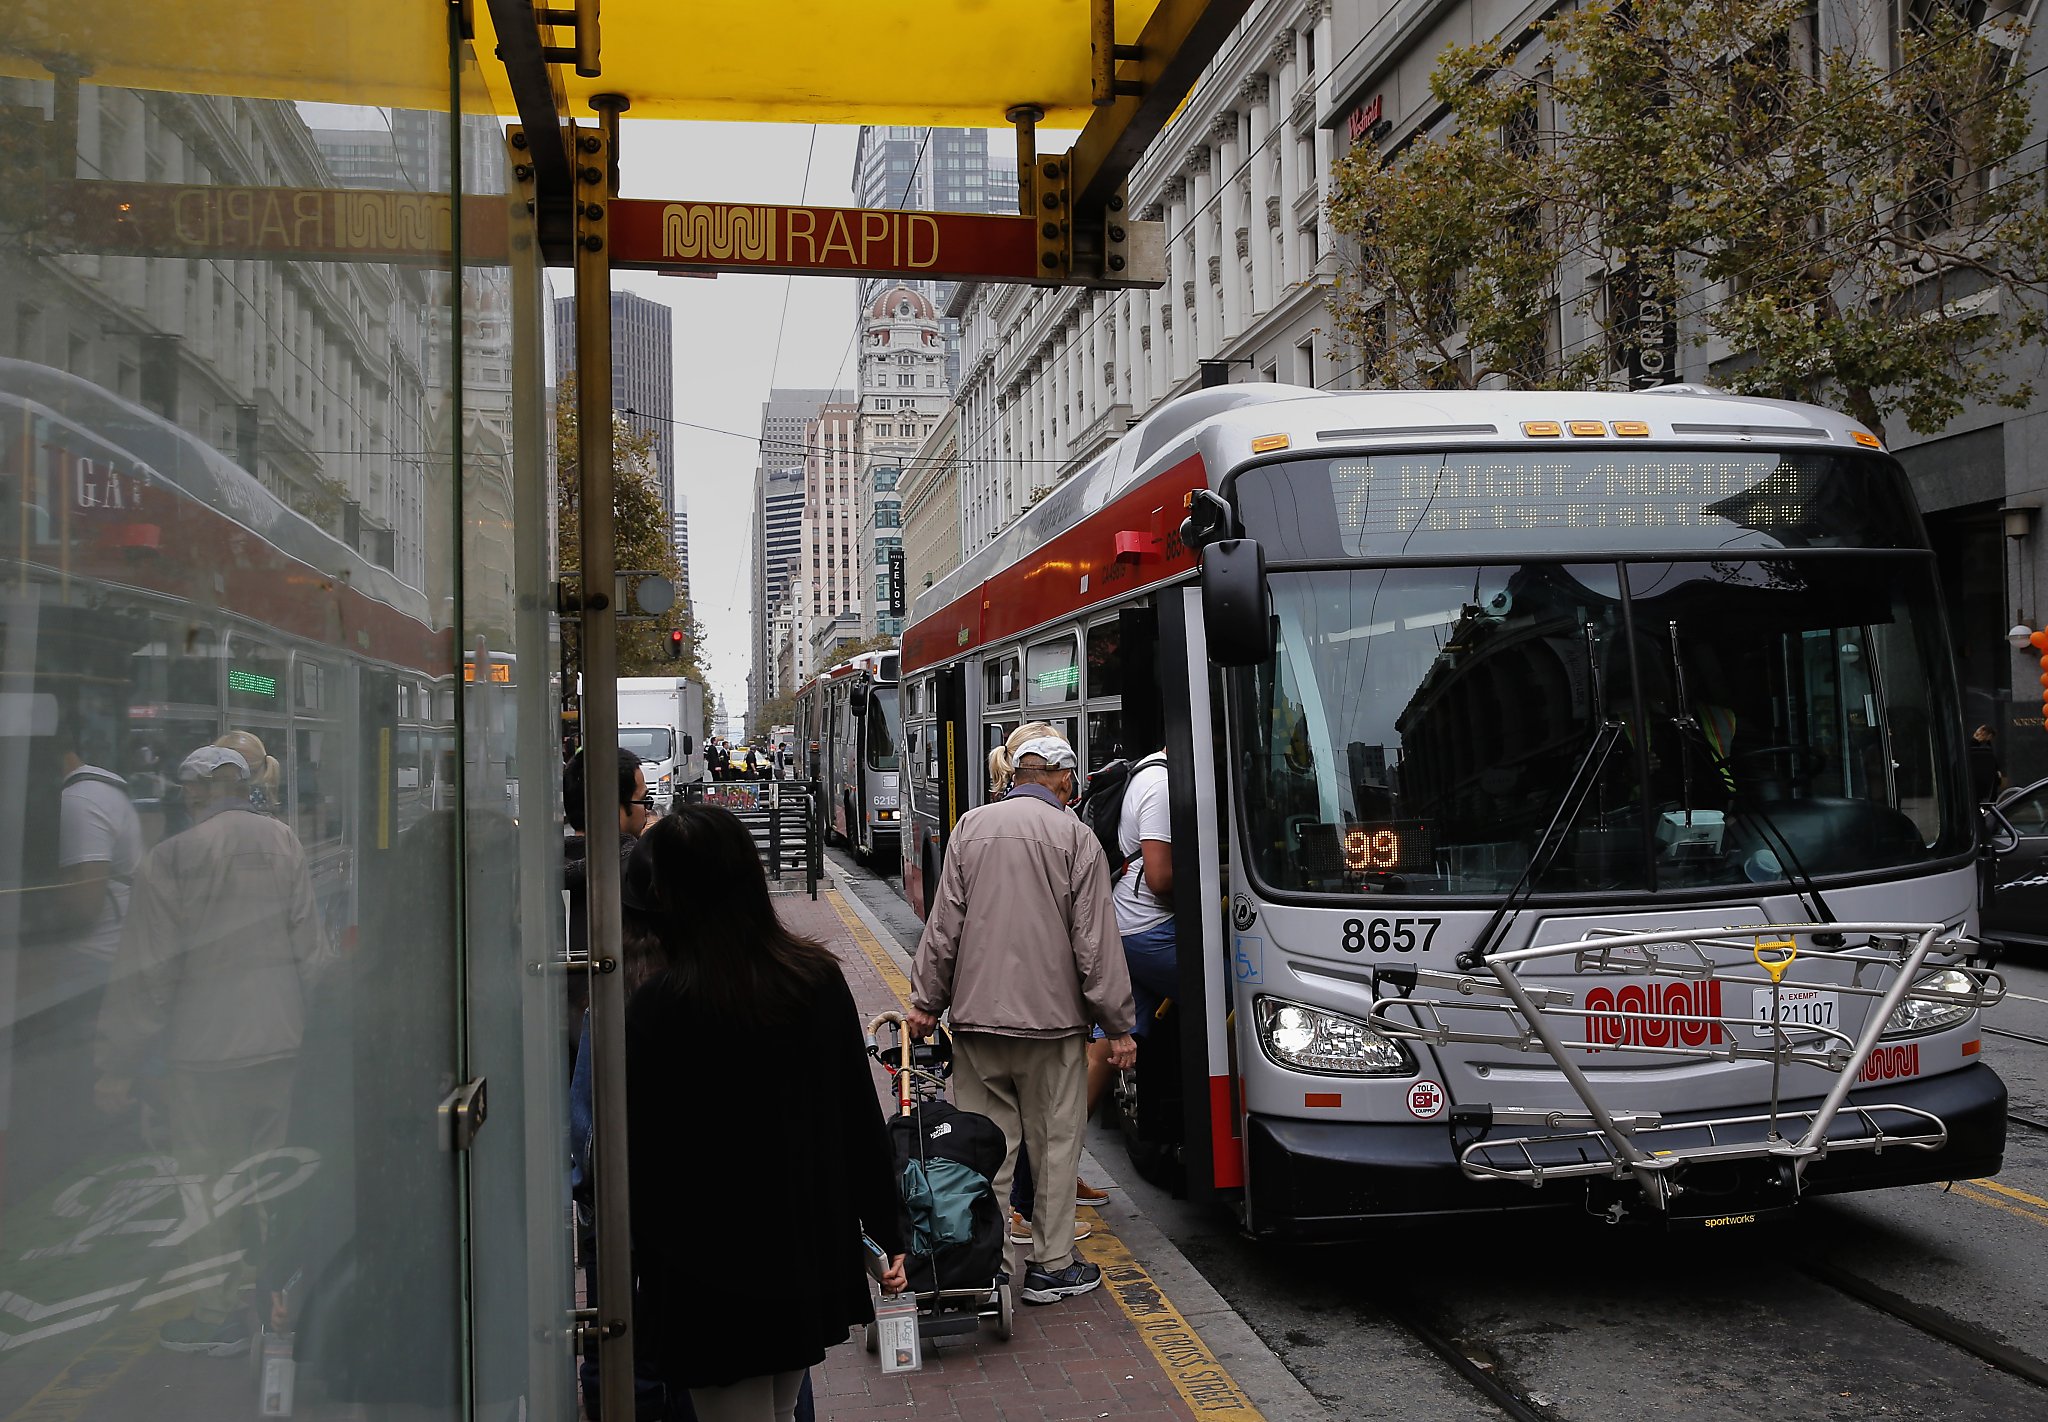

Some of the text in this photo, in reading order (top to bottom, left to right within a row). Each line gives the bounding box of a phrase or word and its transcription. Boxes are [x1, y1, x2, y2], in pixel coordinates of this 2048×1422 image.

[663, 204, 939, 268] MUNI RAPID
[1338, 466, 1374, 527] 7
[893, 561, 901, 608] ZELOS
[873, 795, 897, 805] 6215
[1344, 830, 1398, 869] 99
[1341, 918, 1442, 953] 8657
[1788, 991, 1818, 1001] EXEMPT
[1705, 1214, 1755, 1227] sportworks
[1140, 1318, 1245, 1411] TO CROSS STREET
